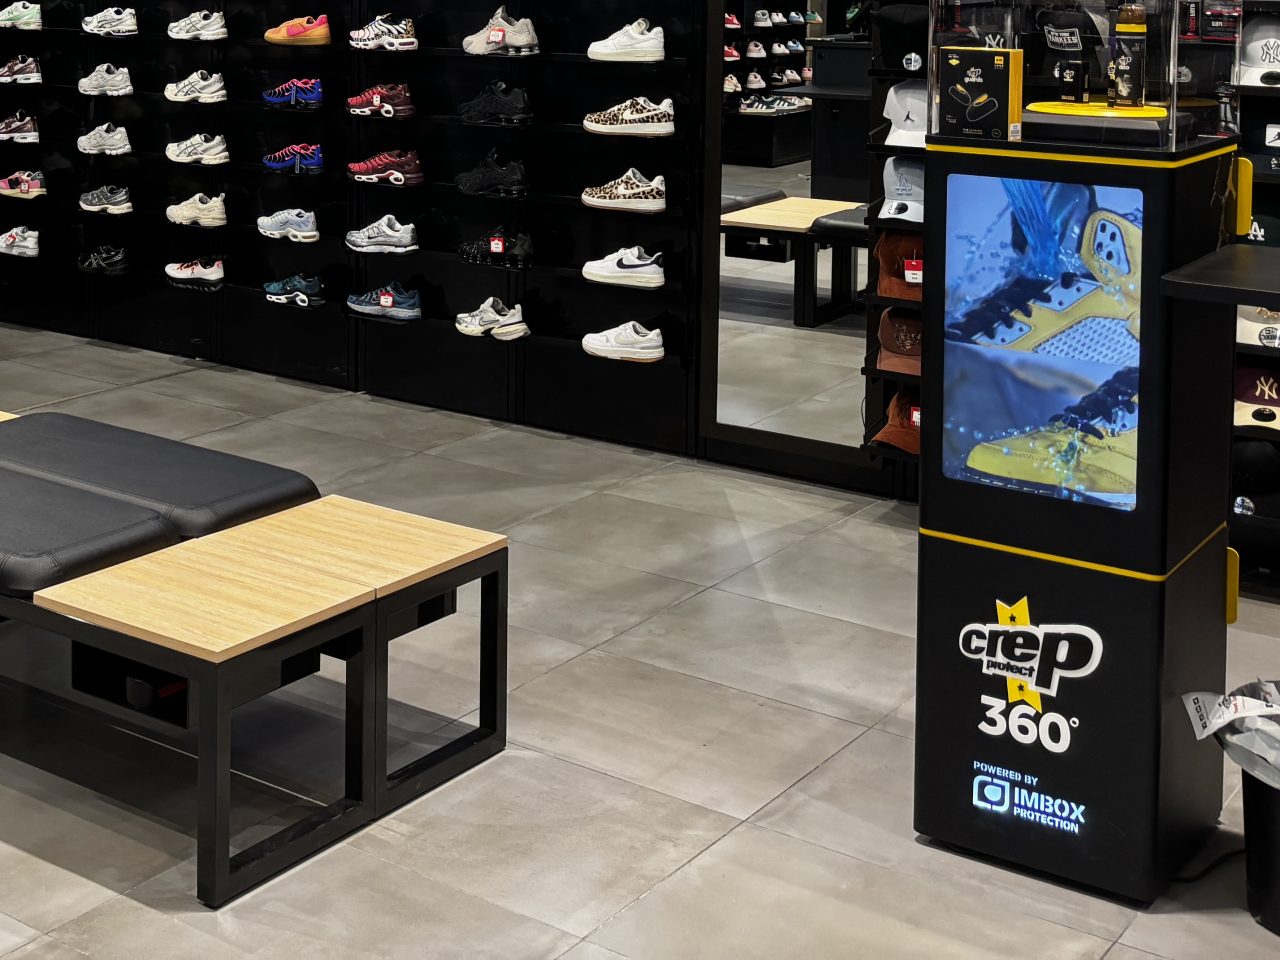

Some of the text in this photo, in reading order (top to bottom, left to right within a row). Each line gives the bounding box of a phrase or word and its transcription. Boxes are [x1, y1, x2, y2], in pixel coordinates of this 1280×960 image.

[961, 628, 1094, 690] crep
[986, 659, 1036, 677] protect
[973, 760, 1038, 786] POWERED BY
[1014, 786, 1085, 823] IMBOX
[1013, 806, 1079, 834] PROTECTION
